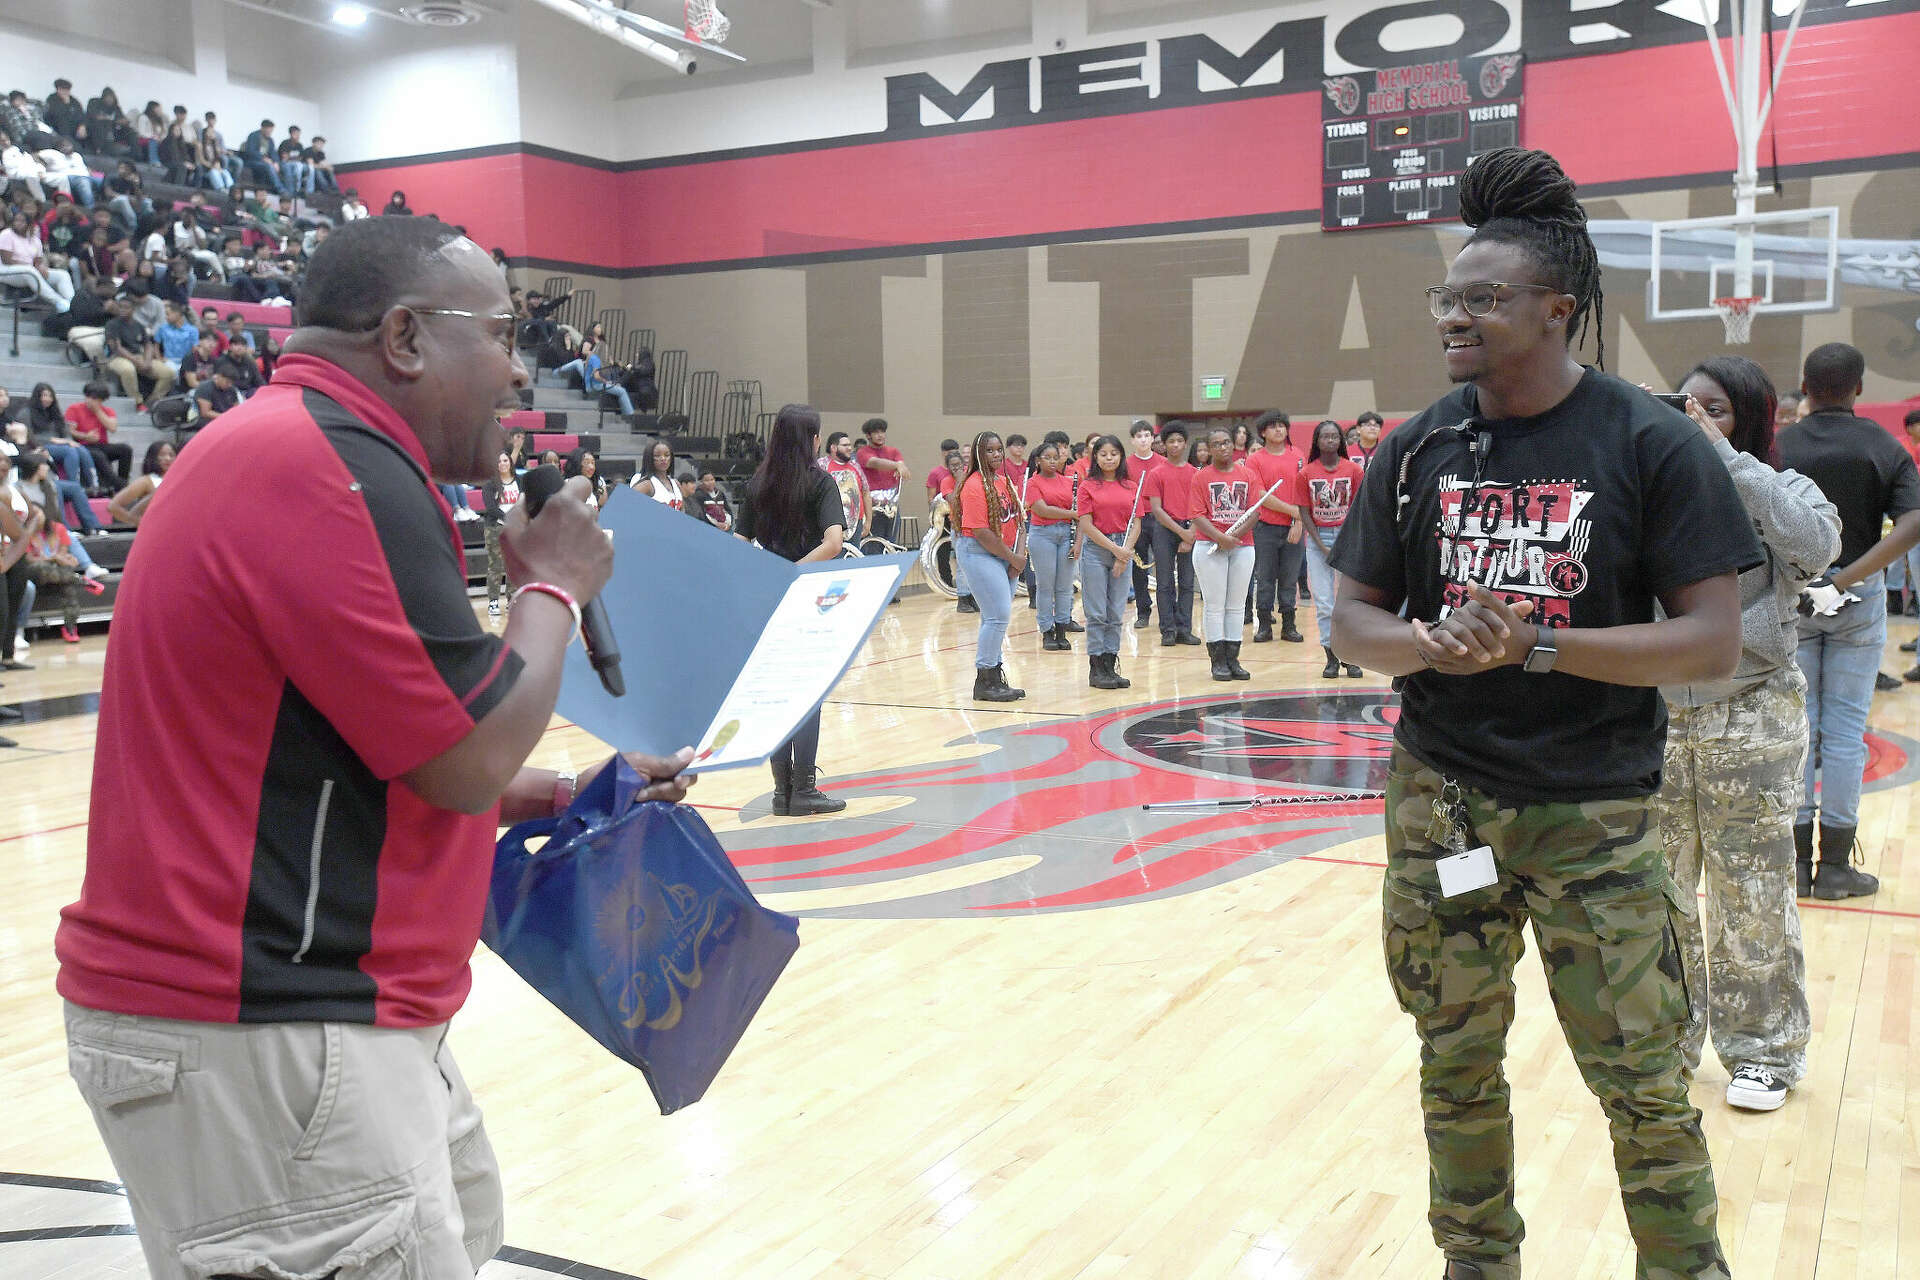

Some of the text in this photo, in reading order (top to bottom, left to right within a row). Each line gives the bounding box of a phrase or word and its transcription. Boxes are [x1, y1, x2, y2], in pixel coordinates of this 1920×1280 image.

[1376, 59, 1462, 90] MEMORIAL
[1367, 80, 1472, 114] HIGH SCHOOL
[1469, 104, 1517, 121] VISITOR
[1326, 121, 1367, 137] TITANS
[1337, 184, 1364, 196] FOULS
[1388, 175, 1455, 191] PLAYER FOULS
[1459, 487, 1559, 537] PORT
[1439, 537, 1547, 588] ARTHUR
